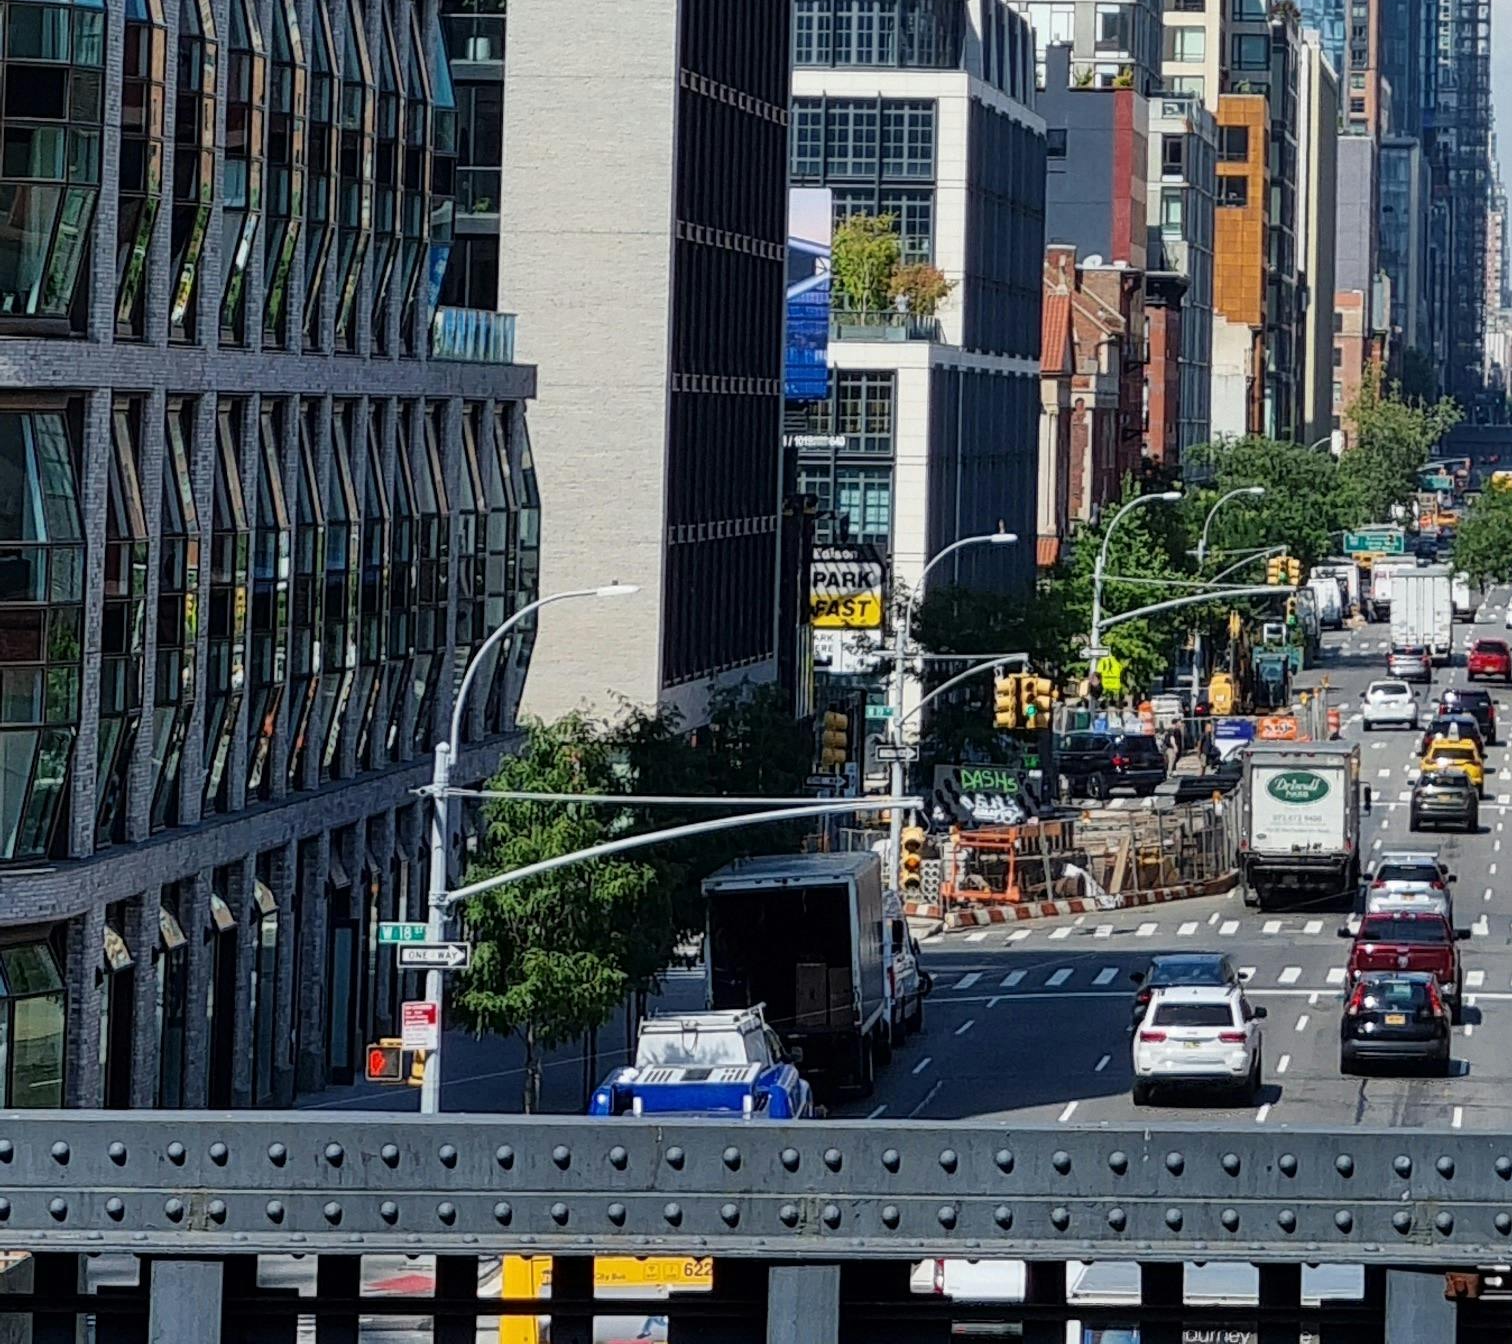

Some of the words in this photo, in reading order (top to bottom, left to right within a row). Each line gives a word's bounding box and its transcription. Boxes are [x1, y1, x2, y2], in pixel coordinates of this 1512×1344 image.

[813, 571, 874, 588] PARK
[813, 599, 872, 618] FAST
[381, 926, 393, 940] W
[399, 926, 413, 940] 18
[408, 951, 428, 960] ONE
[437, 951, 459, 960] WAY
